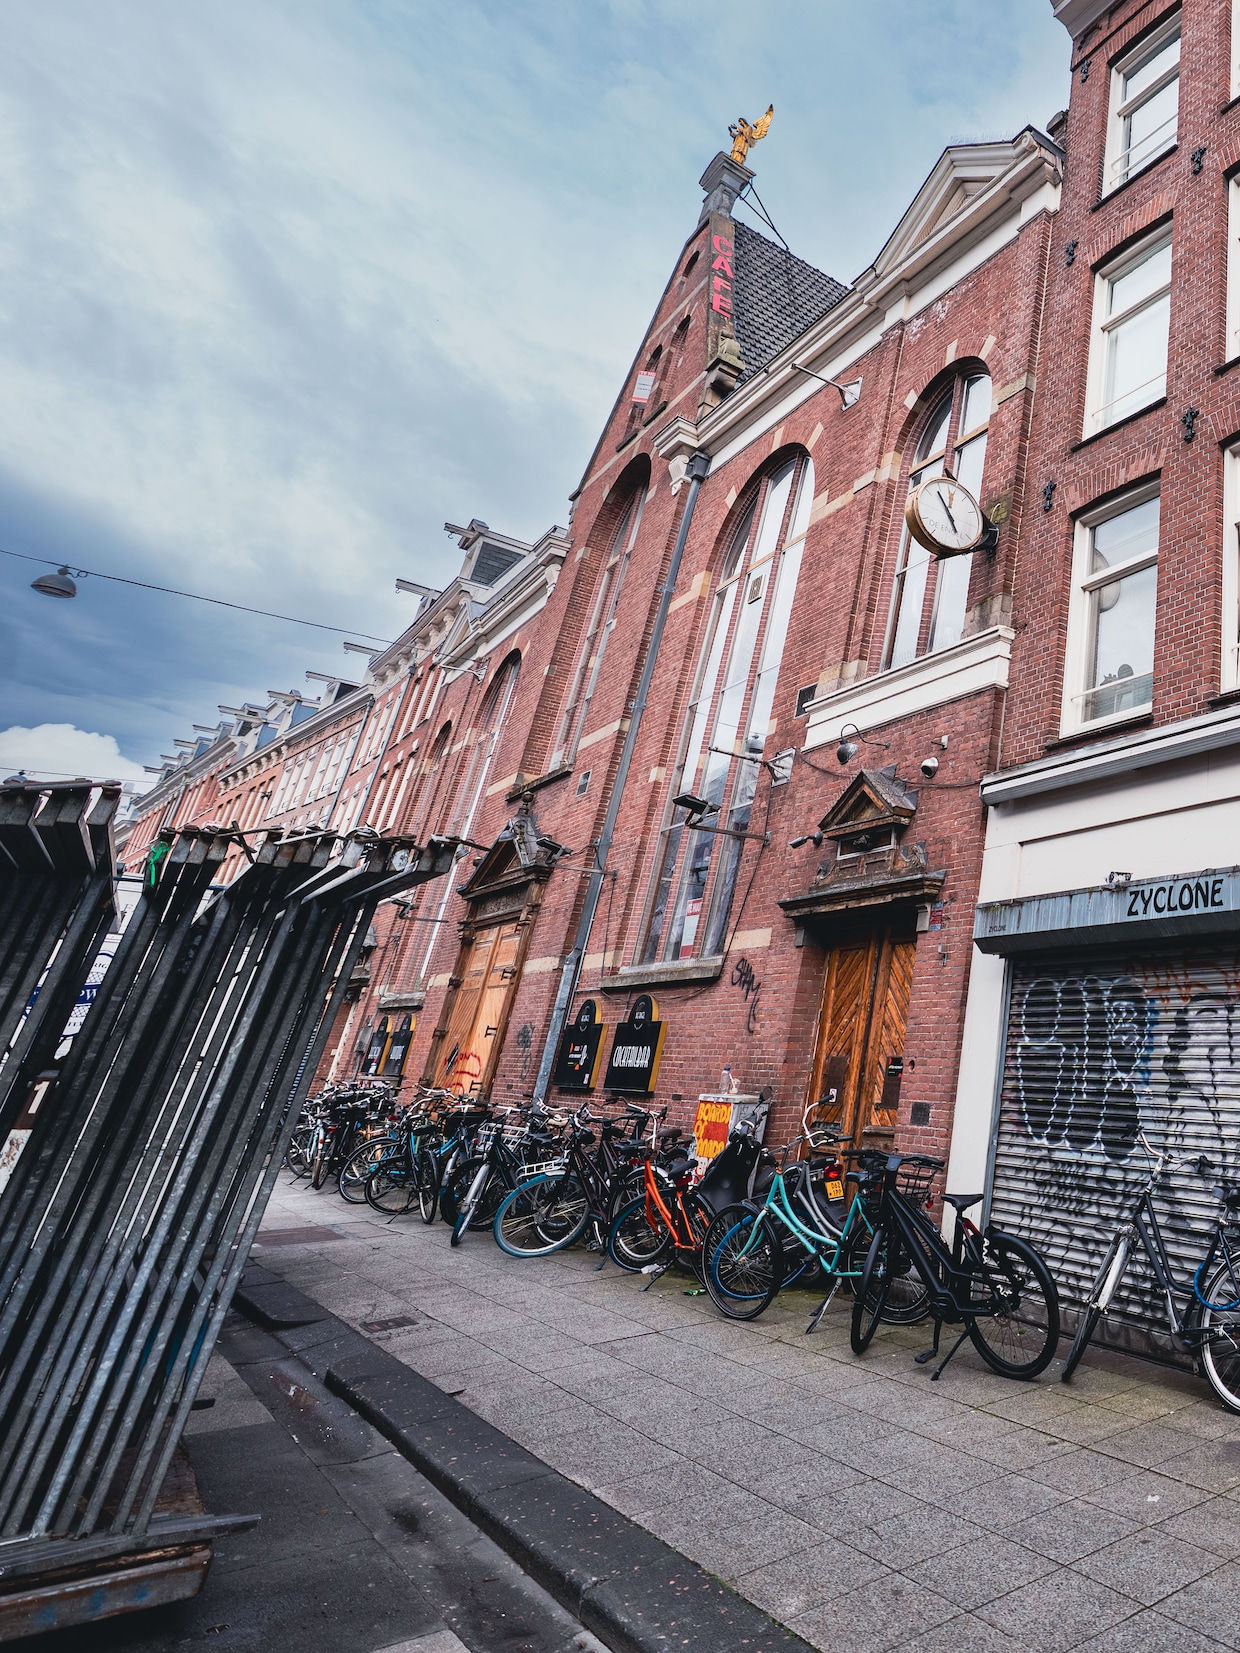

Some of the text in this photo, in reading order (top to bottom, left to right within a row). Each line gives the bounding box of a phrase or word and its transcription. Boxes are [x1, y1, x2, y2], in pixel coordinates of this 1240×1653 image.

[711, 235, 734, 318] CAFE
[929, 520, 939, 529] DE
[1127, 879, 1225, 916] ZYCLONE
[612, 1045, 651, 1069] COCKTAILBAR
